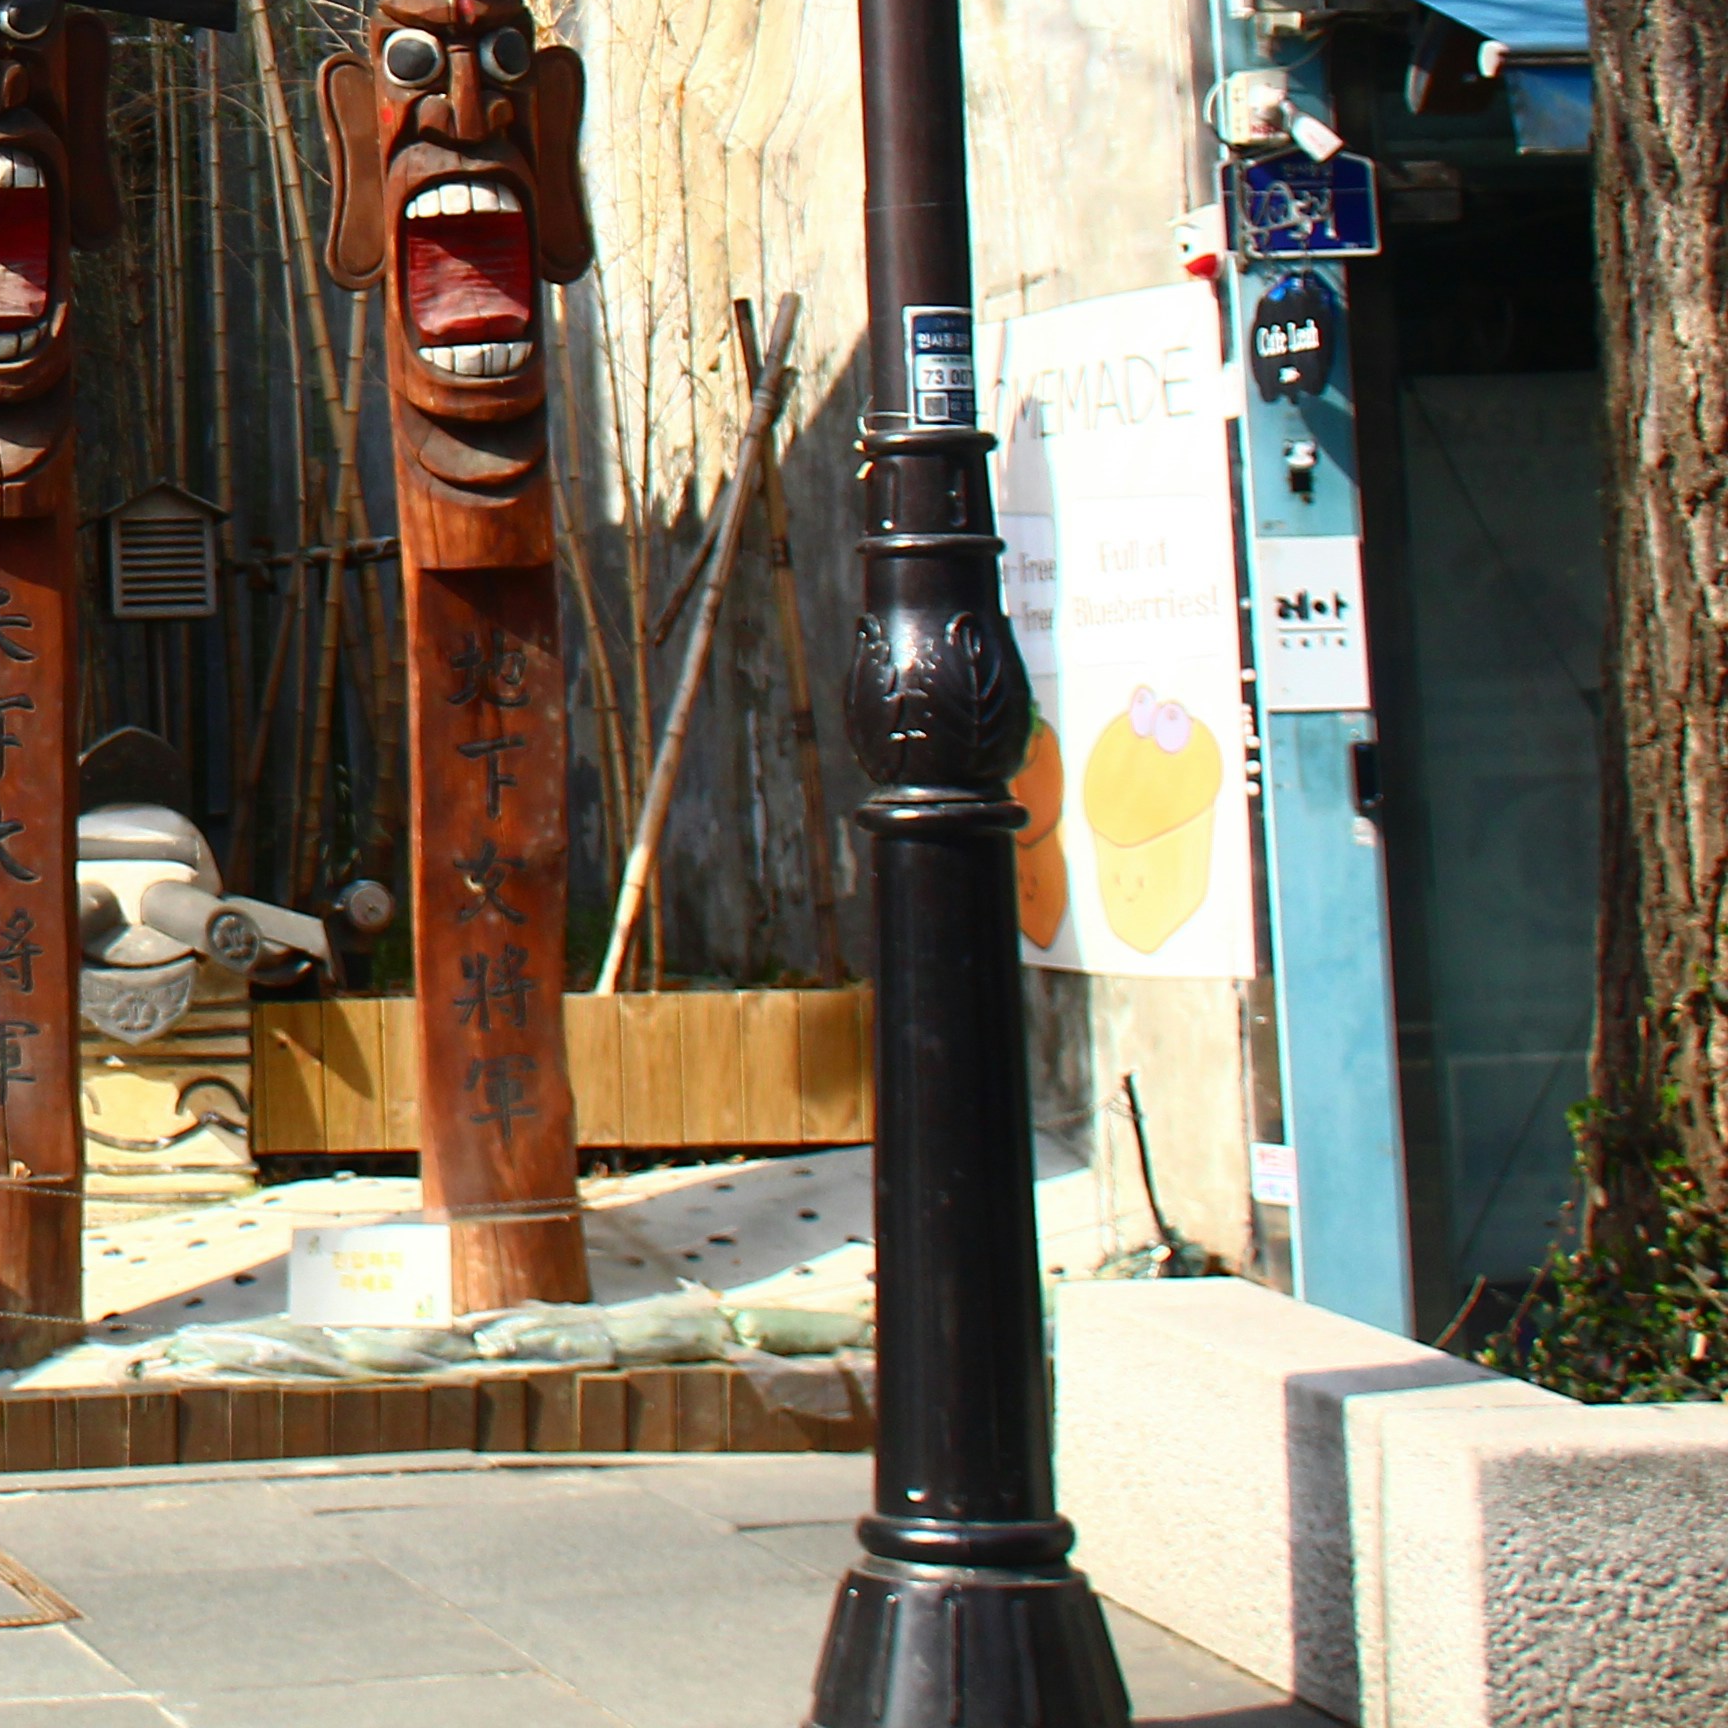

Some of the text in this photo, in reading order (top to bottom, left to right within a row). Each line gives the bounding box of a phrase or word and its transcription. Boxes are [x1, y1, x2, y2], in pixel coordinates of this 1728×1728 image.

[1098, 537, 1141, 573] Full
[1071, 584, 1221, 628] Blueberries!
[446, 628, 541, 1142] 地下女將軍
